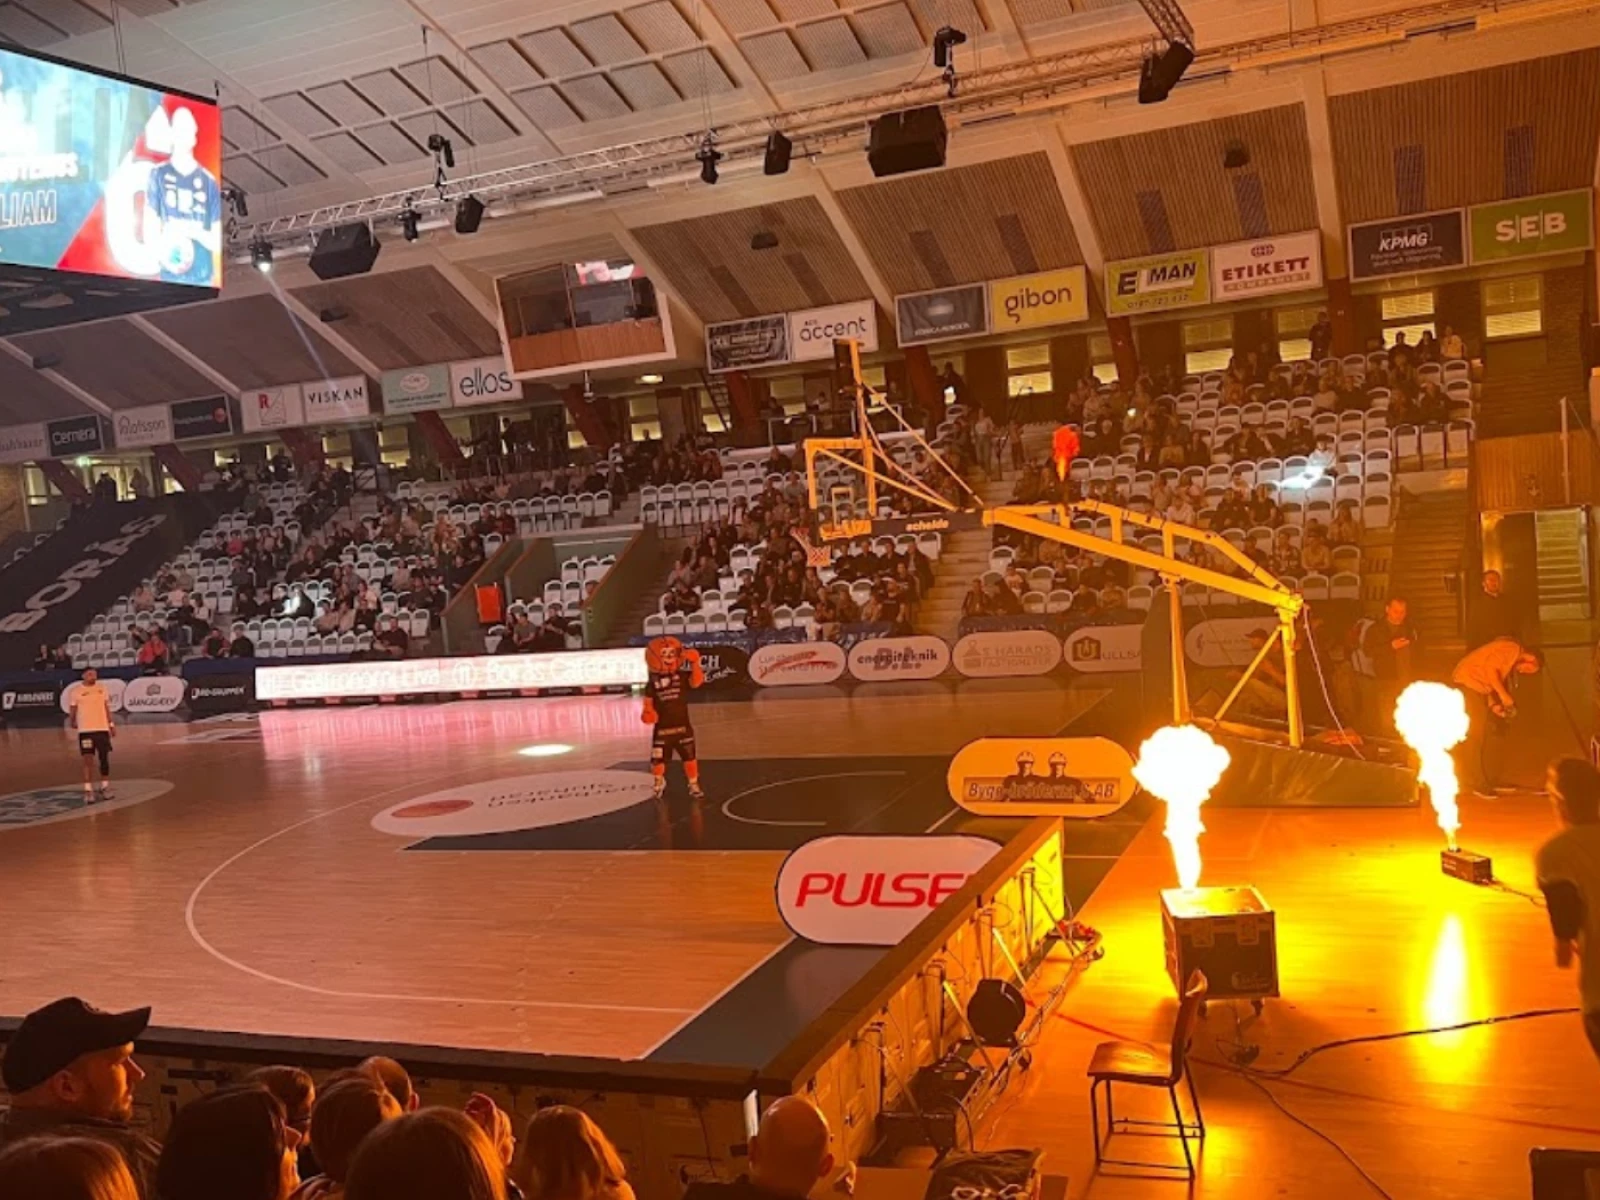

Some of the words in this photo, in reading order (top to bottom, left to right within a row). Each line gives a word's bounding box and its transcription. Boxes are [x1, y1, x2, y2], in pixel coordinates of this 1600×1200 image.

[1496, 210, 1567, 243] SEB
[1378, 232, 1429, 252] KPMG
[1221, 256, 1311, 282] ETIKETT
[1004, 284, 1072, 322] gibon
[800, 315, 867, 342] accent
[308, 385, 364, 405] VISKAN
[459, 367, 513, 398] ellos
[0, 514, 168, 633] BORÅS
[857, 647, 939, 667] energiteknik
[795, 872, 977, 908] PULSE
